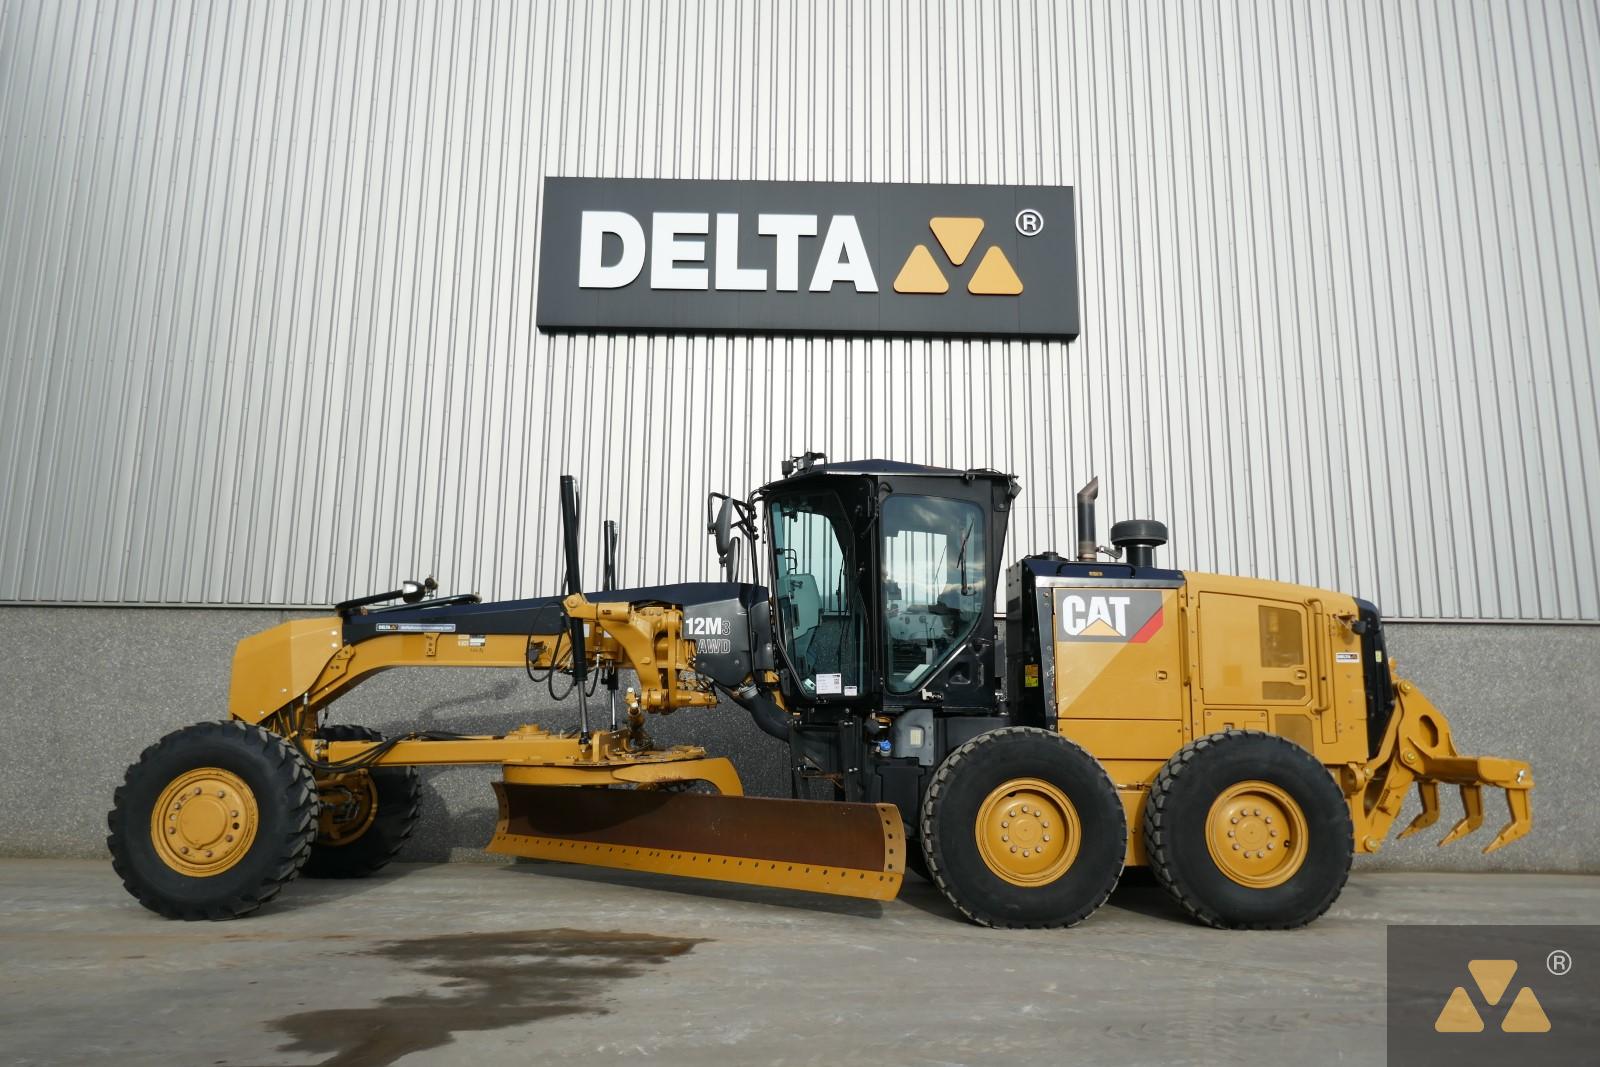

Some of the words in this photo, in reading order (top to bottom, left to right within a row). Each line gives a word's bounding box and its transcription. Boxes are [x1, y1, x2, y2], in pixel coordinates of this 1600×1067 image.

[578, 210, 880, 293] DELTA
[1062, 594, 1131, 637] CAT
[696, 638, 731, 654] AWD
